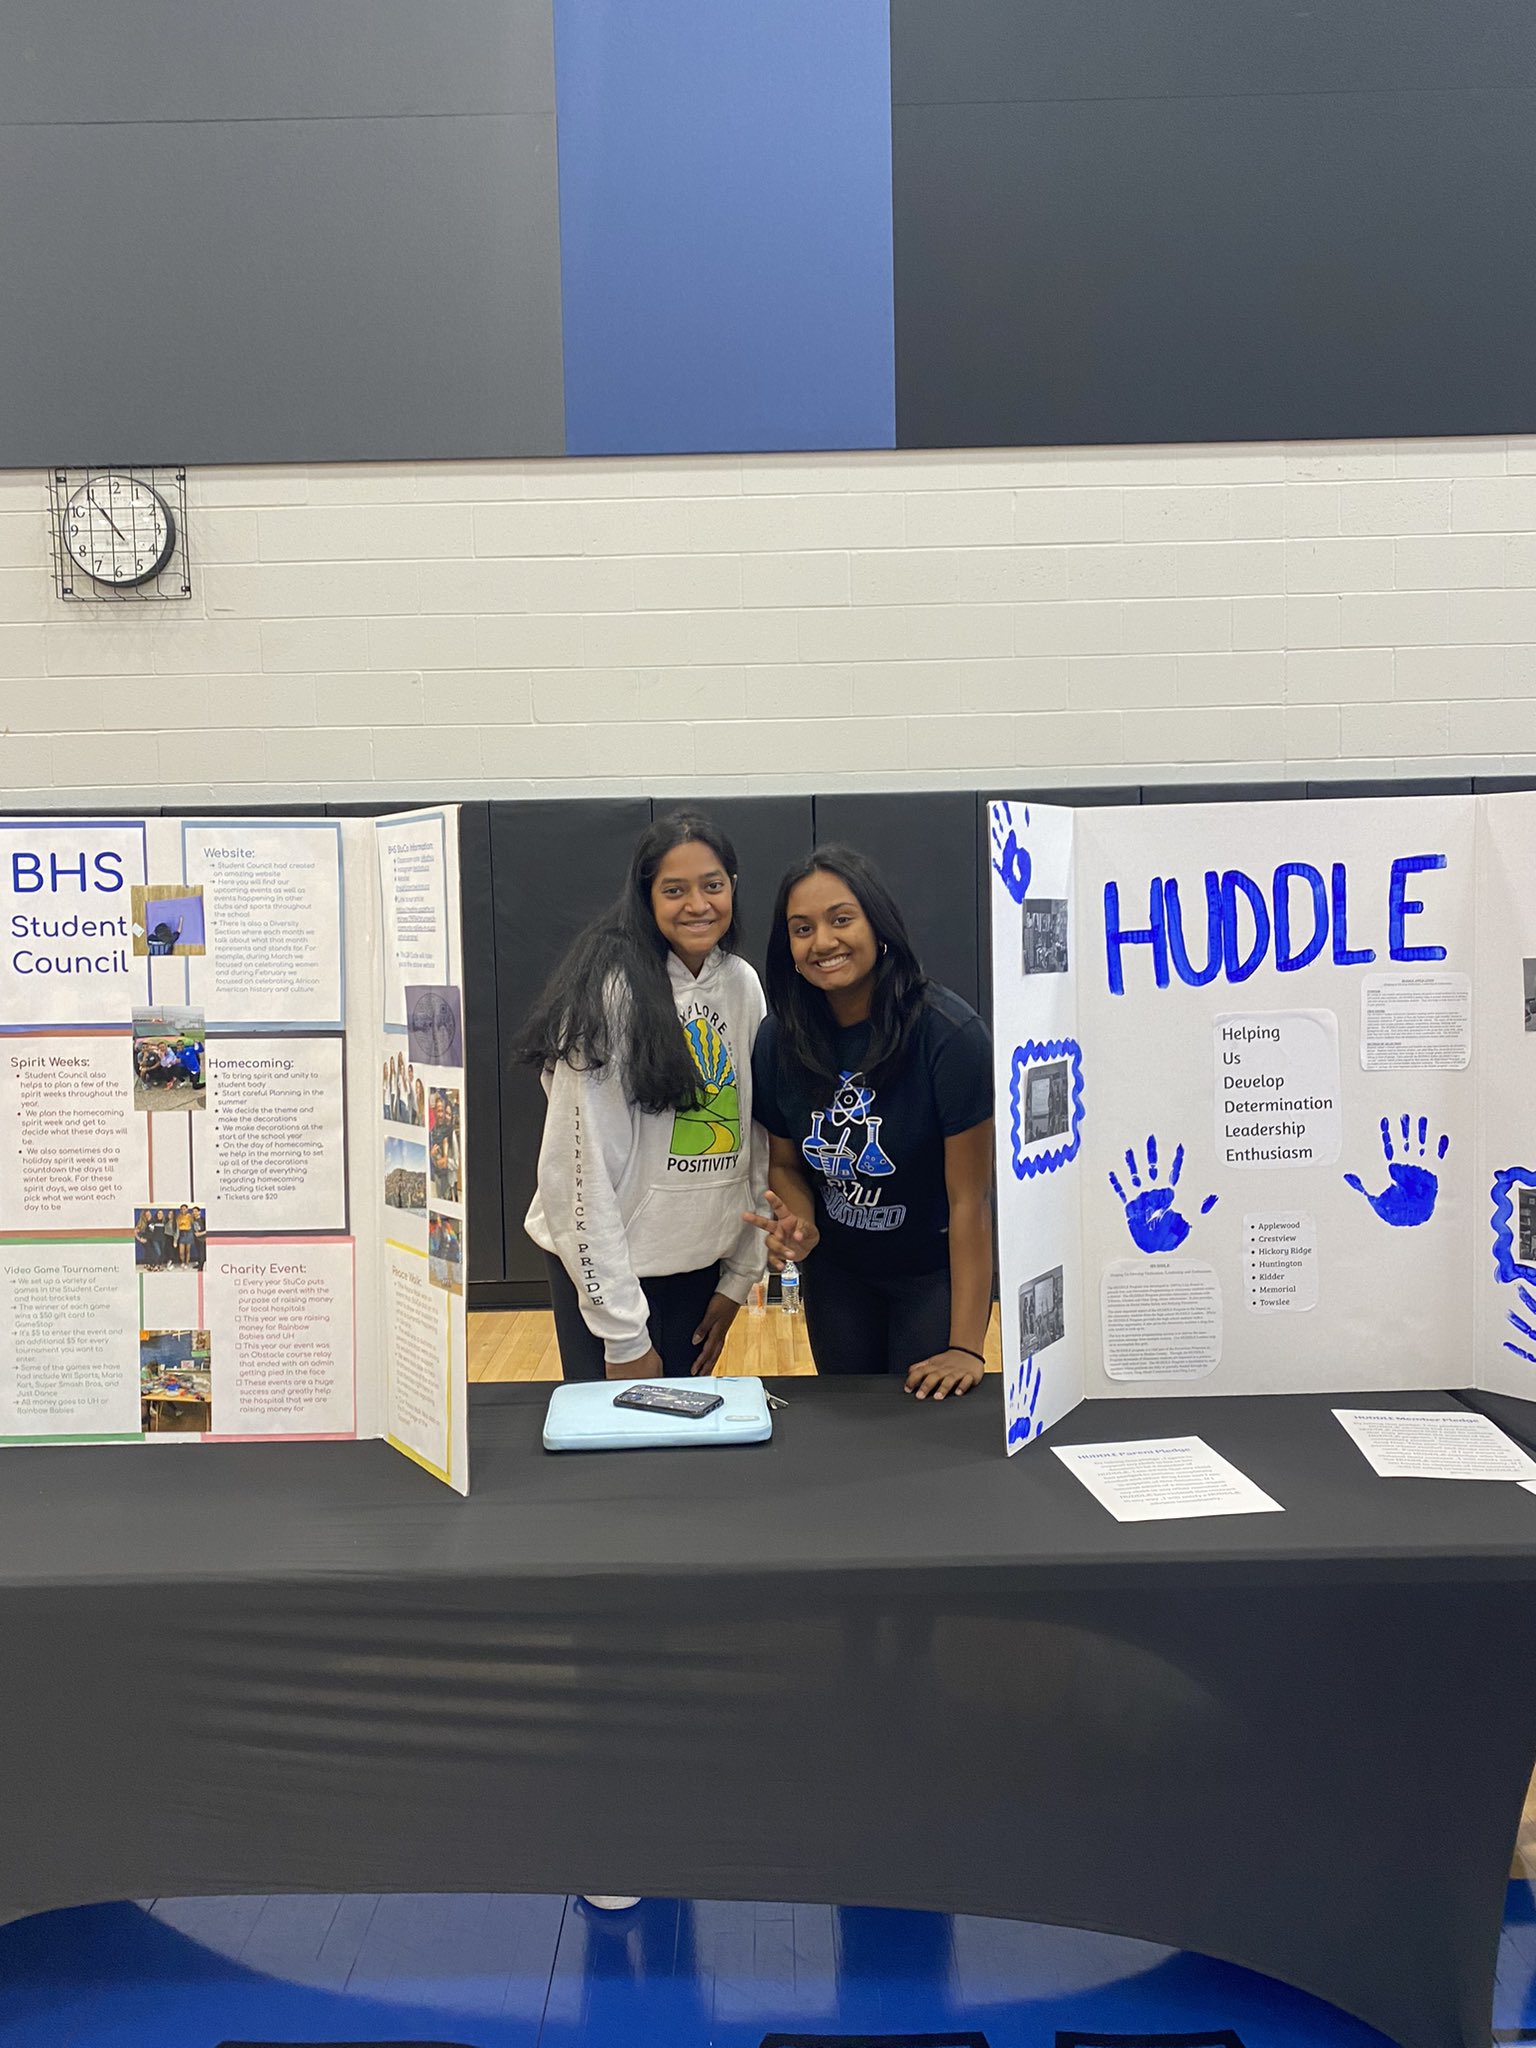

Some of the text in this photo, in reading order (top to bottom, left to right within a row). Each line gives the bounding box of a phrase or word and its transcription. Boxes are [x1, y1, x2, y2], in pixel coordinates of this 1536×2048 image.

[135, 488, 139, 499] 1
[72, 506, 85, 518] 10
[149, 504, 156, 516] 2
[71, 525, 78, 537] 9
[155, 523, 161, 535] 3
[79, 545, 86, 557] 8
[148, 544, 155, 555] 4
[95, 560, 102, 572] 7
[137, 559, 143, 571] 5
[116, 566, 122, 577] 6
[204, 848, 255, 858] Website:
[12, 852, 123, 893] BHS
[12, 915, 128, 938] Student
[1104, 854, 1448, 995] HUDDLE
[13, 950, 128, 974] Council
[679, 1002, 728, 1035] XPLORE
[1222, 1026, 1280, 1044] Helping
[11, 1057, 90, 1069] Spirit Weeks:
[209, 1058, 294, 1070] Homecoming:
[1223, 1052, 1241, 1065] Us
[233, 1072, 251, 1080] bring
[291, 1072, 308, 1080] unity
[21, 1082, 42, 1090] helps
[55, 1081, 72, 1090] plan
[1224, 1074, 1284, 1093] Develop
[21, 1091, 41, 1099] spirit
[68, 1090, 112, 1098] throughout
[1224, 1096, 1333, 1114] Determination
[22, 1120, 42, 1128] spirit
[95, 1128, 113, 1136] days
[1225, 1122, 1306, 1141] Leadership
[1226, 1146, 1313, 1162] Enthusiasm
[668, 1155, 738, 1173] POSITIVITY
[1258, 1222, 1300, 1231] Applewood
[1259, 1247, 1312, 1258] Hickory Ridge
[4, 1266, 31, 1274] Video
[221, 1264, 306, 1276] Charity Event:
[1259, 1260, 1302, 1269] Huntington
[578, 1244, 604, 1306] PRIDE
